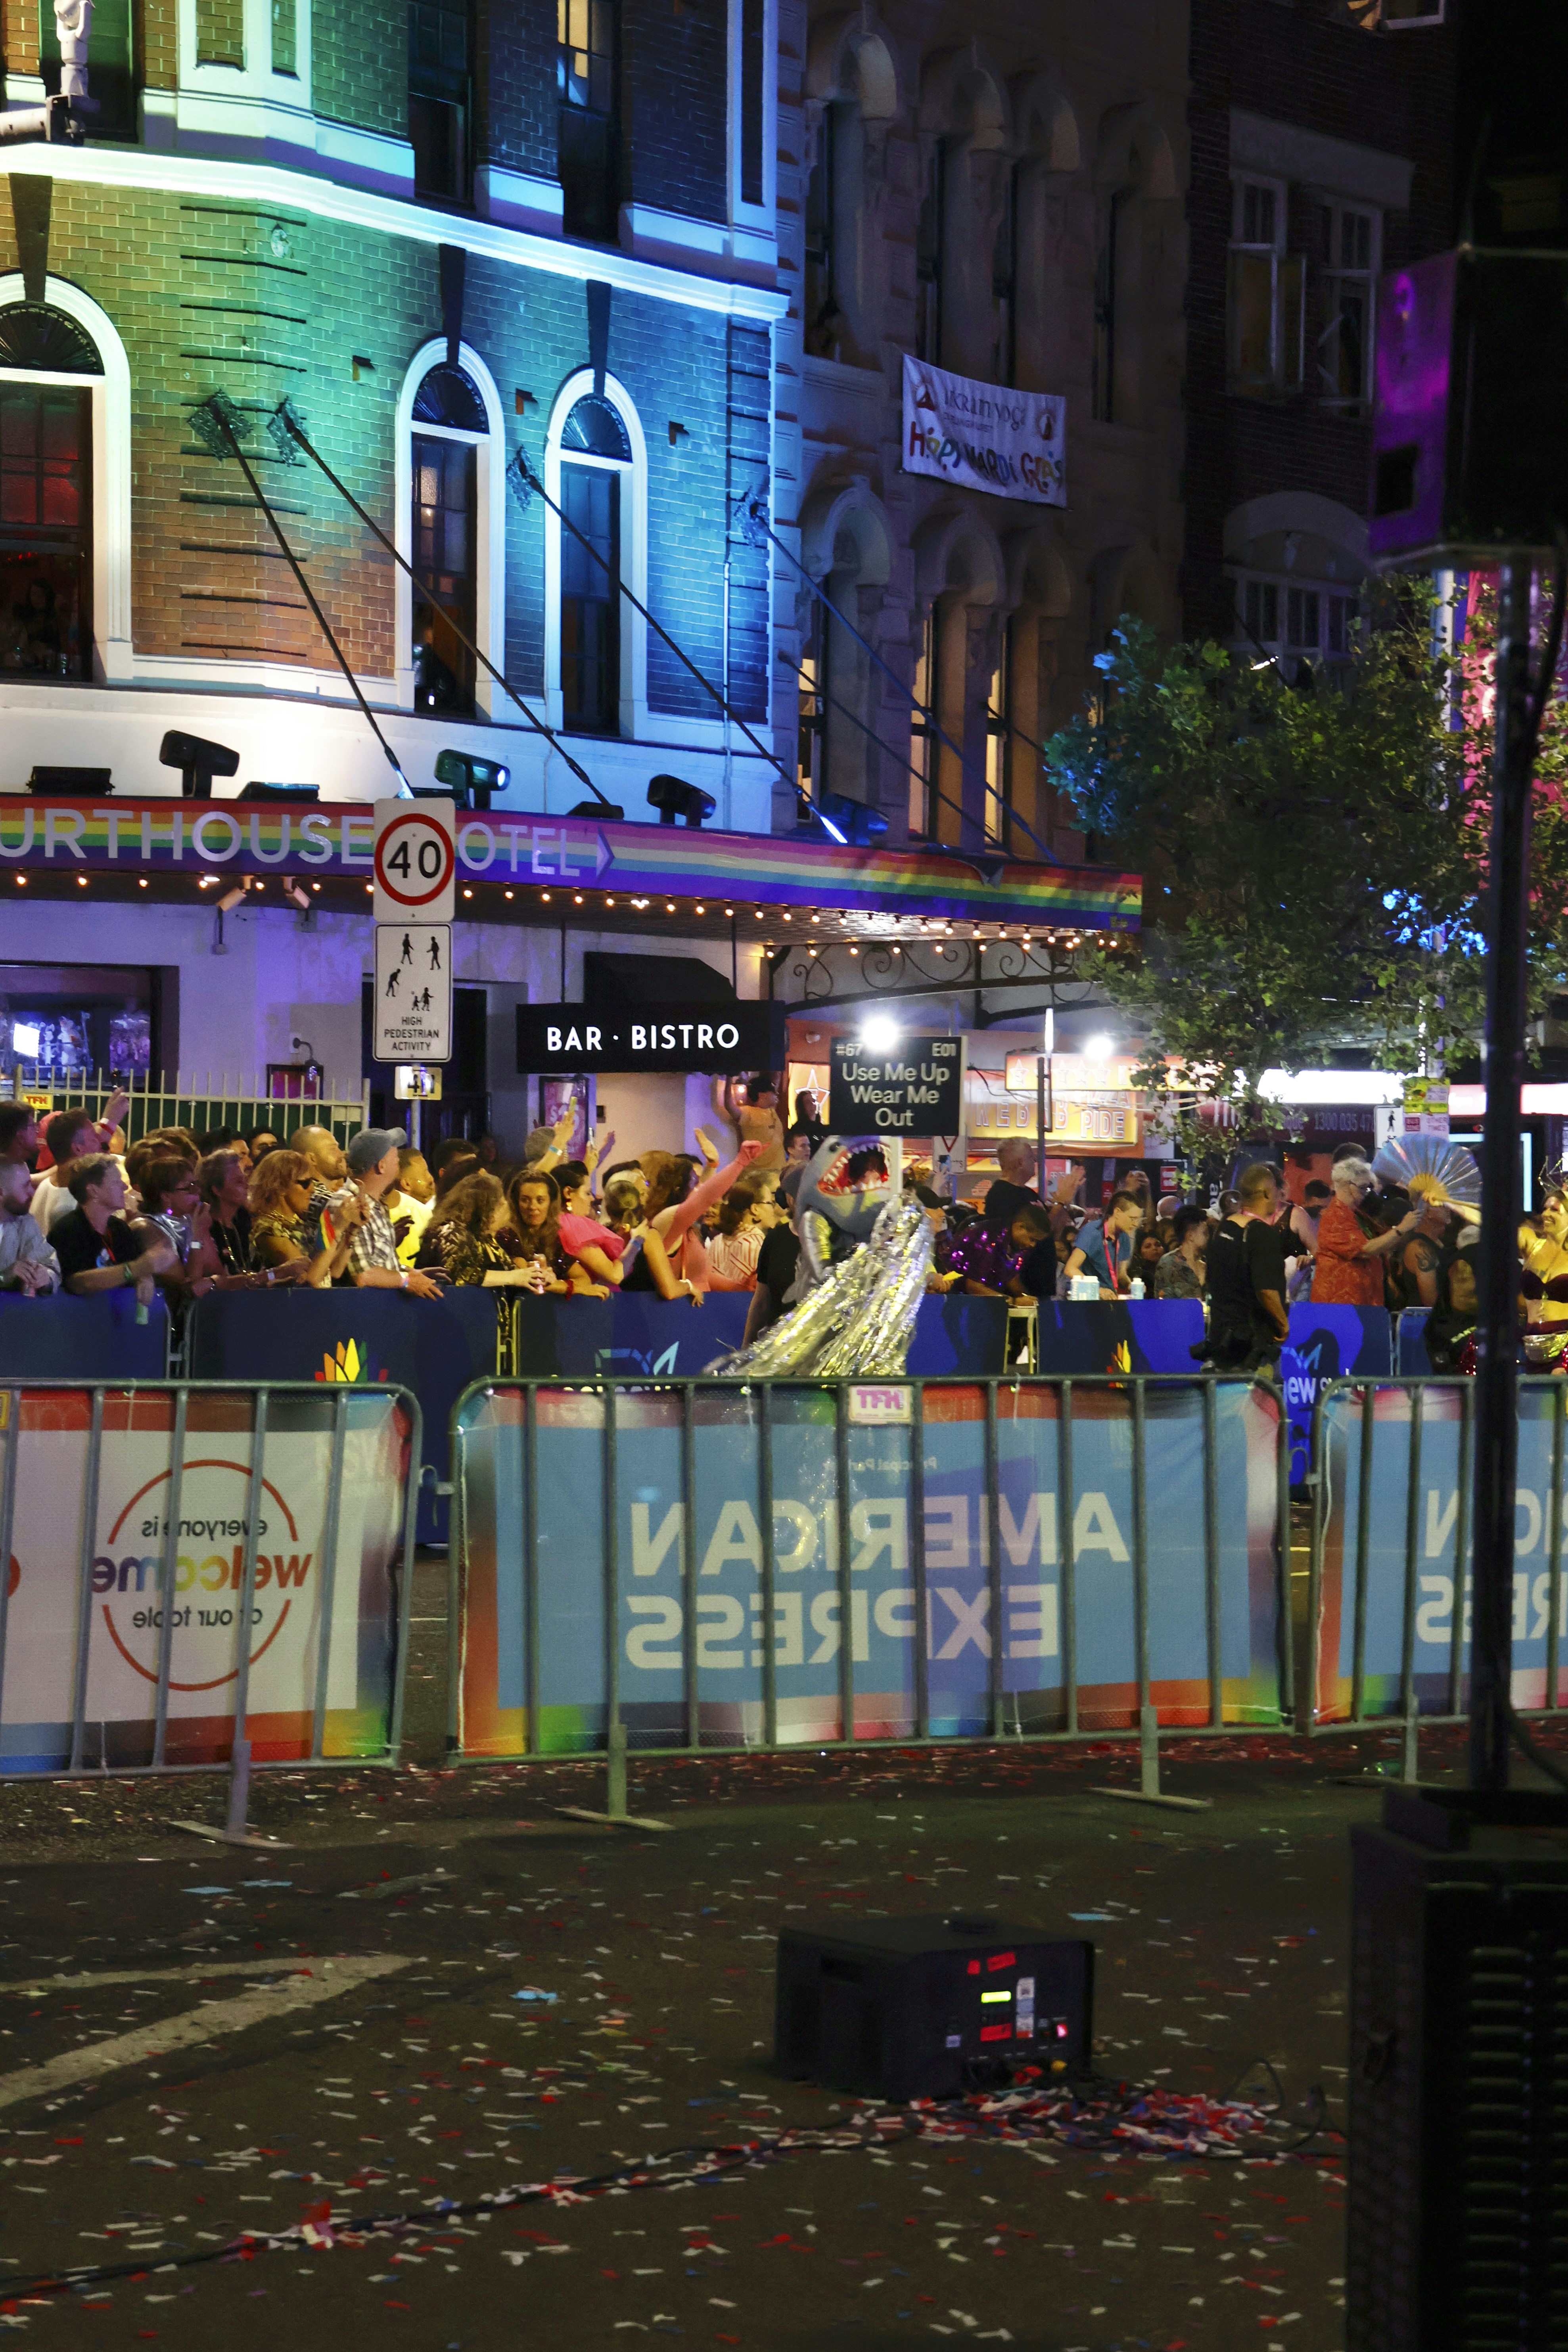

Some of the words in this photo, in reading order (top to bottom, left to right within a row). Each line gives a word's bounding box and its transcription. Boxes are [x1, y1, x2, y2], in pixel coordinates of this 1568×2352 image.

[387, 840, 441, 879] 40
[458, 822, 580, 877] OTEL
[402, 1016, 422, 1026] HIGH
[384, 1029, 439, 1038] PEDESTRIAN
[547, 1026, 603, 1051] BAR
[631, 1024, 739, 1049] BISTRO
[392, 1042, 431, 1050] ACTIVITY
[842, 1062, 881, 1081] Use
[884, 1062, 918, 1081] Me
[920, 1062, 950, 1086] Up
[850, 1085, 904, 1104] Wear
[907, 1085, 940, 1104] Me
[874, 1107, 914, 1127] Out
[1080, 1110, 1125, 1139] PIDE
